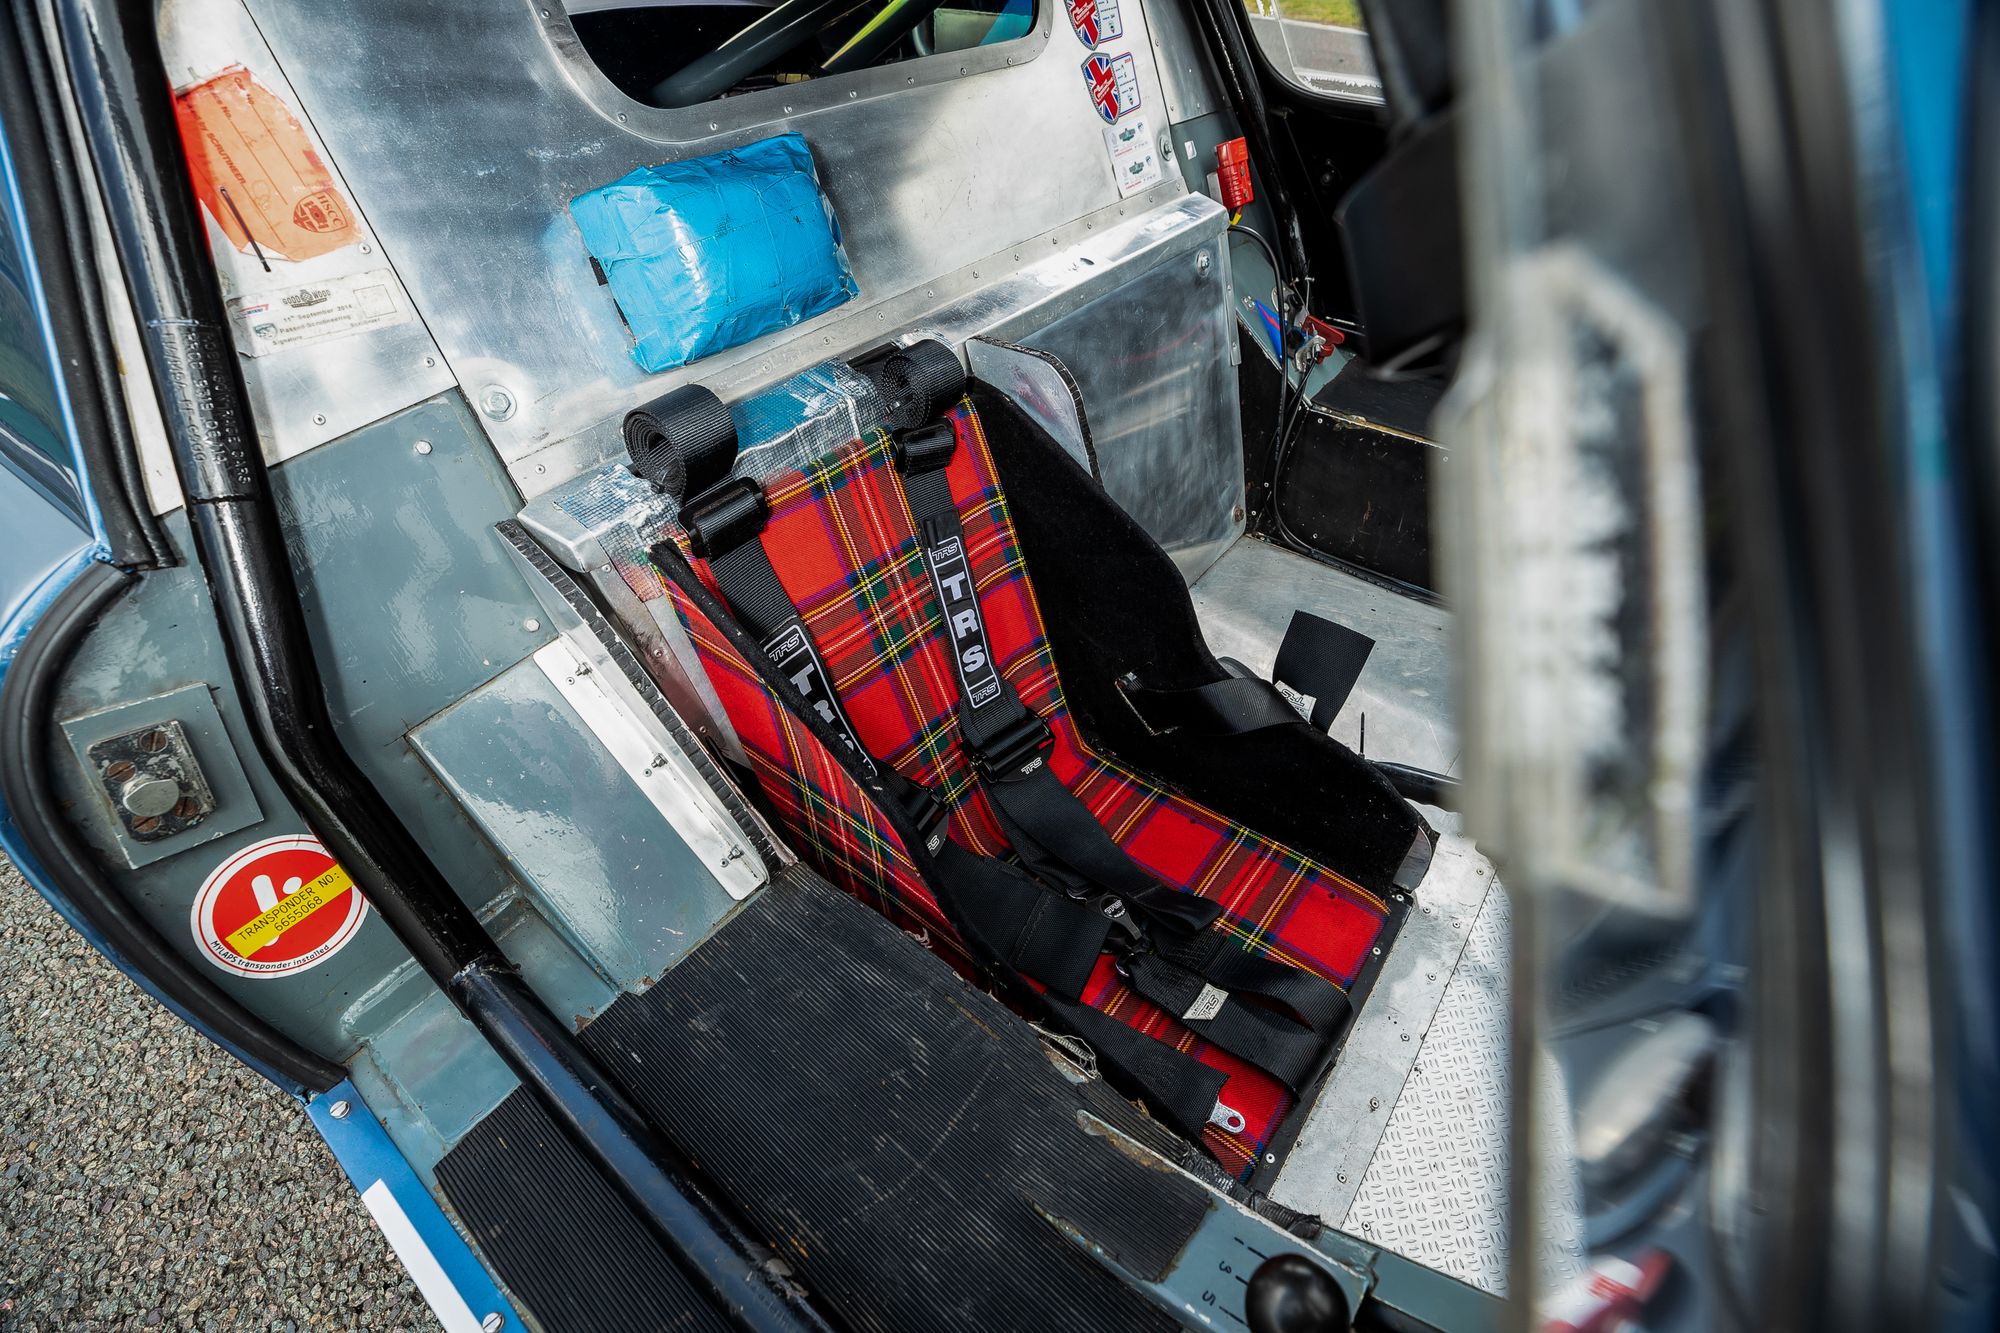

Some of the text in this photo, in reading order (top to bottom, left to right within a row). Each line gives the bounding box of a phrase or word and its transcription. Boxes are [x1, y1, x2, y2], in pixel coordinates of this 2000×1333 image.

[207, 133, 246, 184] SCRUTINEER
[316, 194, 344, 226] HSCC
[932, 543, 958, 561] TRS
[769, 633, 800, 662] TRS
[972, 682, 997, 702] TRS
[1021, 757, 1043, 775] TRS
[237, 886, 316, 941] TRANSPONDER
[274, 896, 323, 932] 6655068
[210, 940, 330, 971] MYLAPS transponder installed
[1201, 994, 1219, 1020] TRS
[1218, 1260, 1232, 1274] 3
[1202, 1290, 1216, 1306] 5
